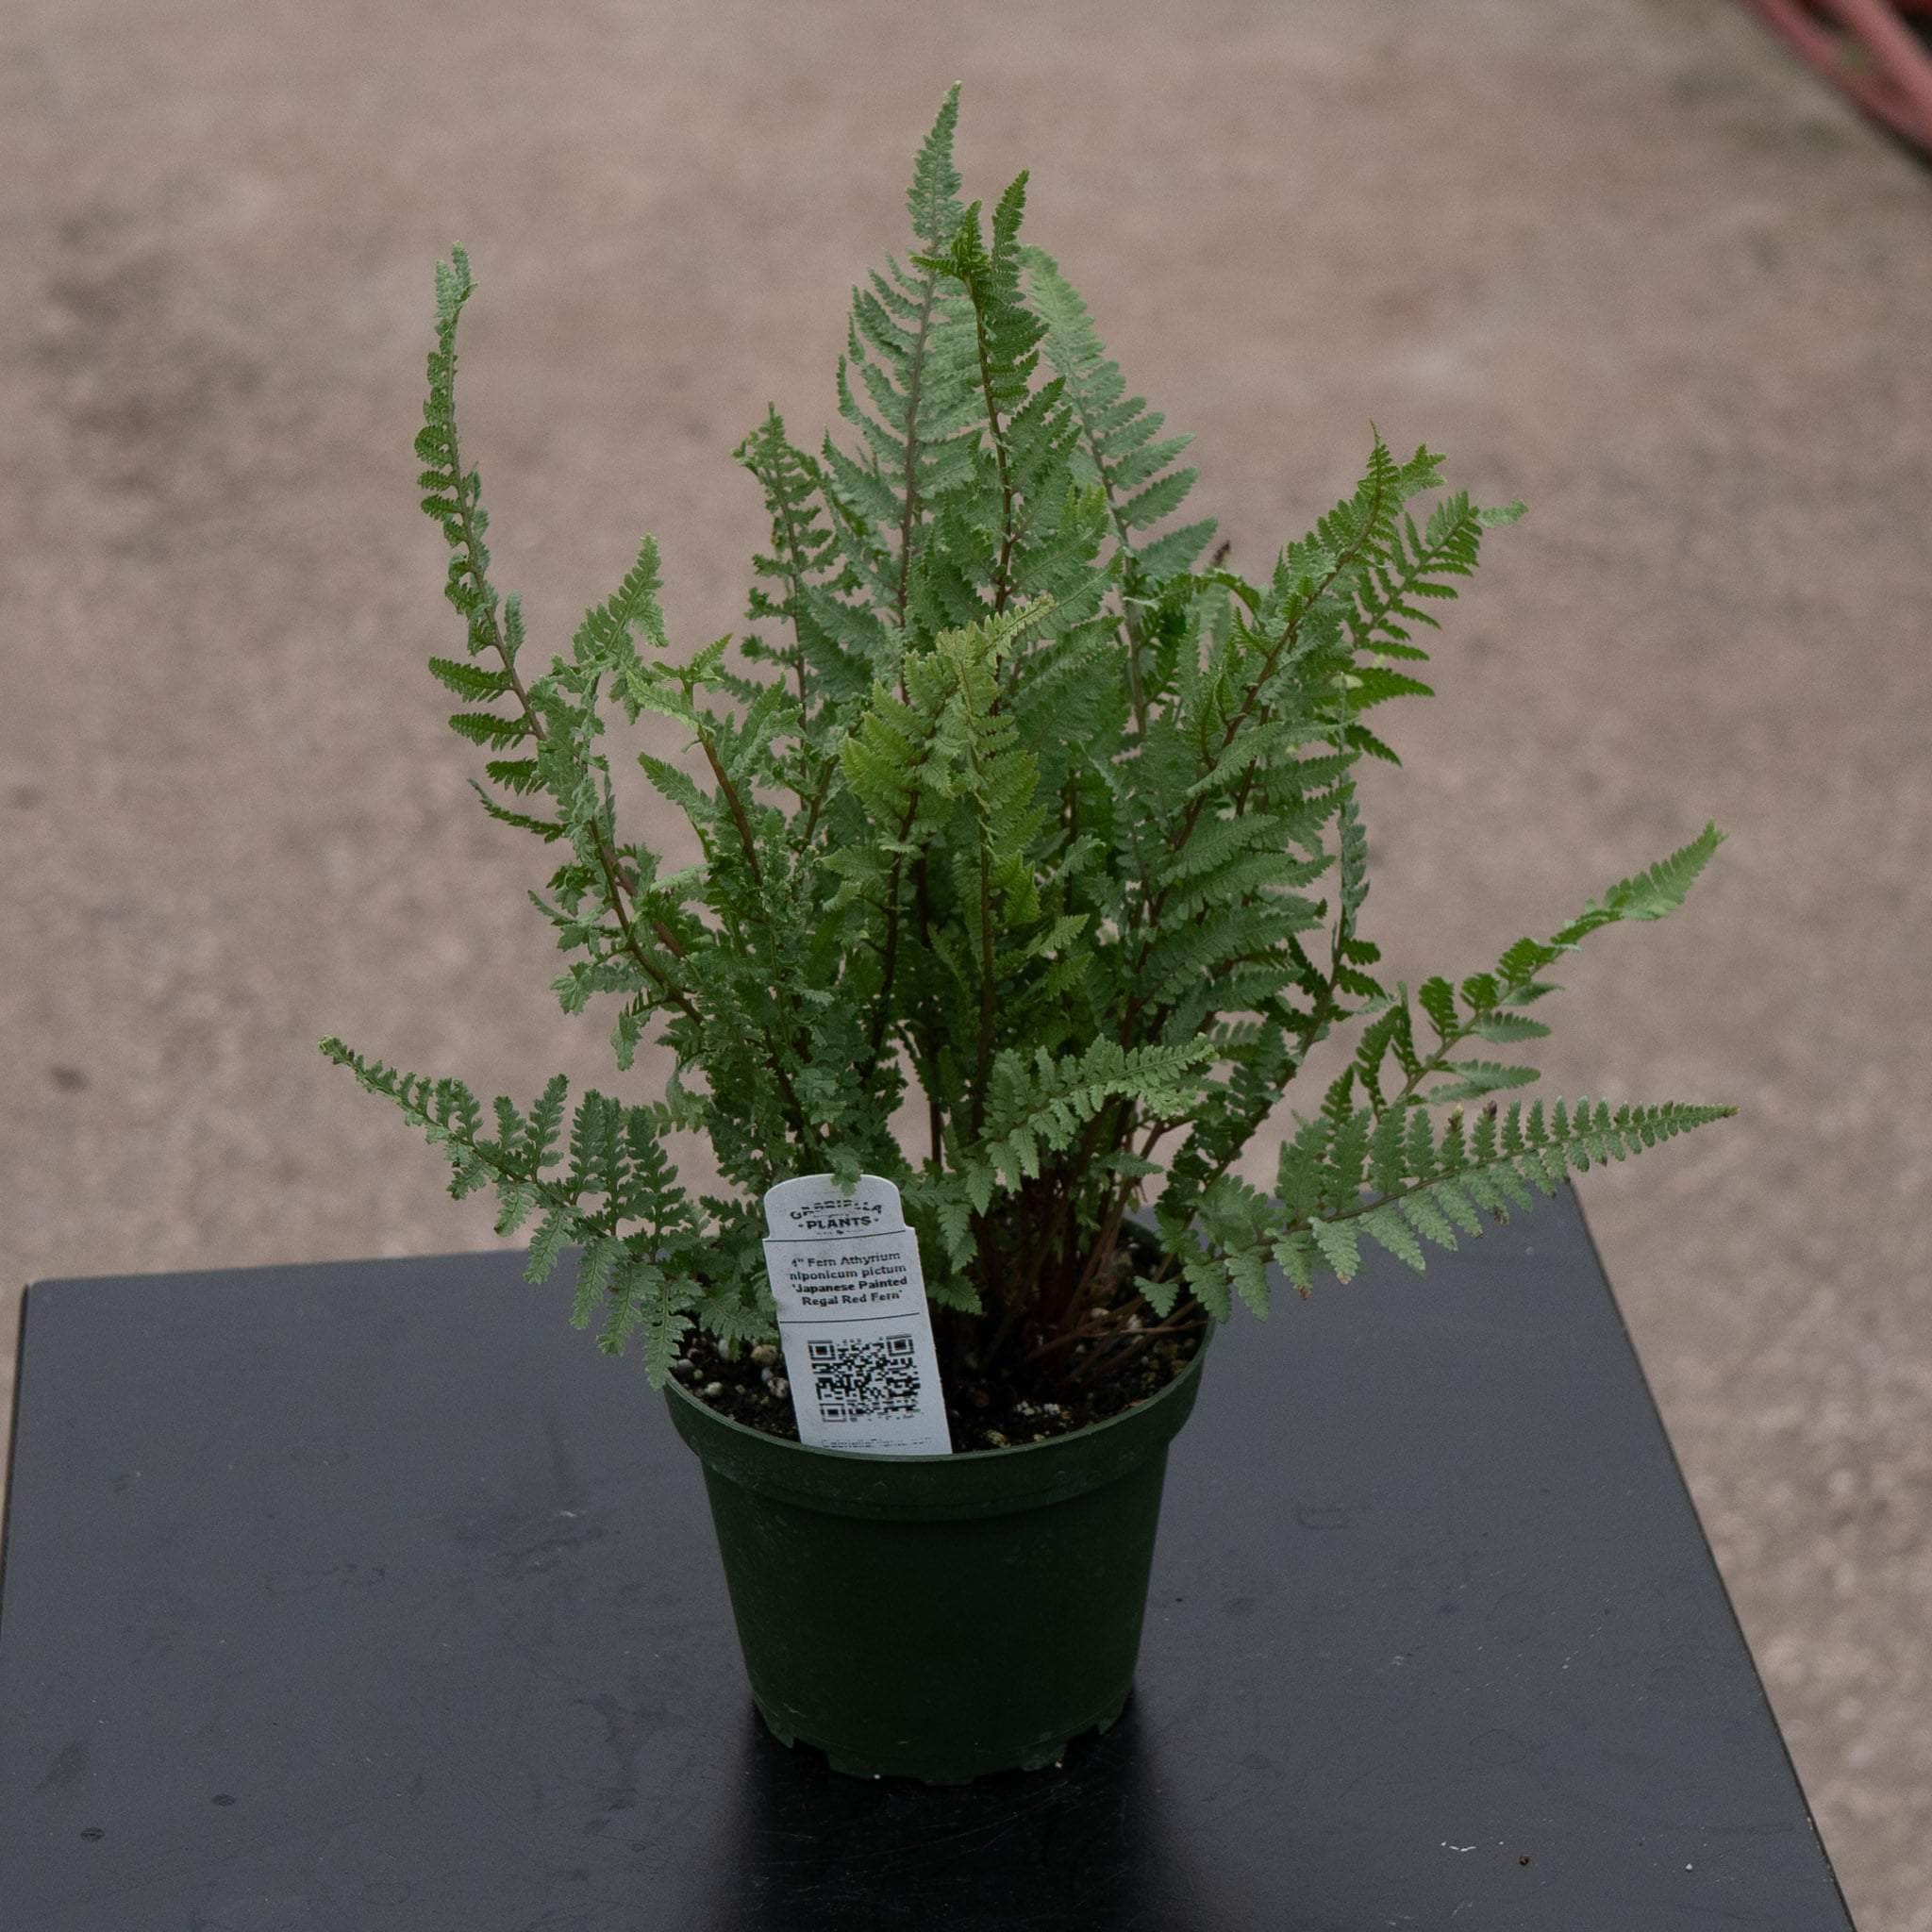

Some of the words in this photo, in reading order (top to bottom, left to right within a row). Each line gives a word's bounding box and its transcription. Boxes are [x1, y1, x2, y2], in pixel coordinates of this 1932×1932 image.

[806, 1216, 872, 1229] PLANTS
[808, 1257, 836, 1267] Fern
[841, 1253, 900, 1265] Athyrium
[790, 1270, 858, 1282] niponicum
[861, 1265, 907, 1278] pictum
[858, 1276, 908, 1290] Painted
[801, 1295, 838, 1307] Regal
[841, 1293, 867, 1305] Red
